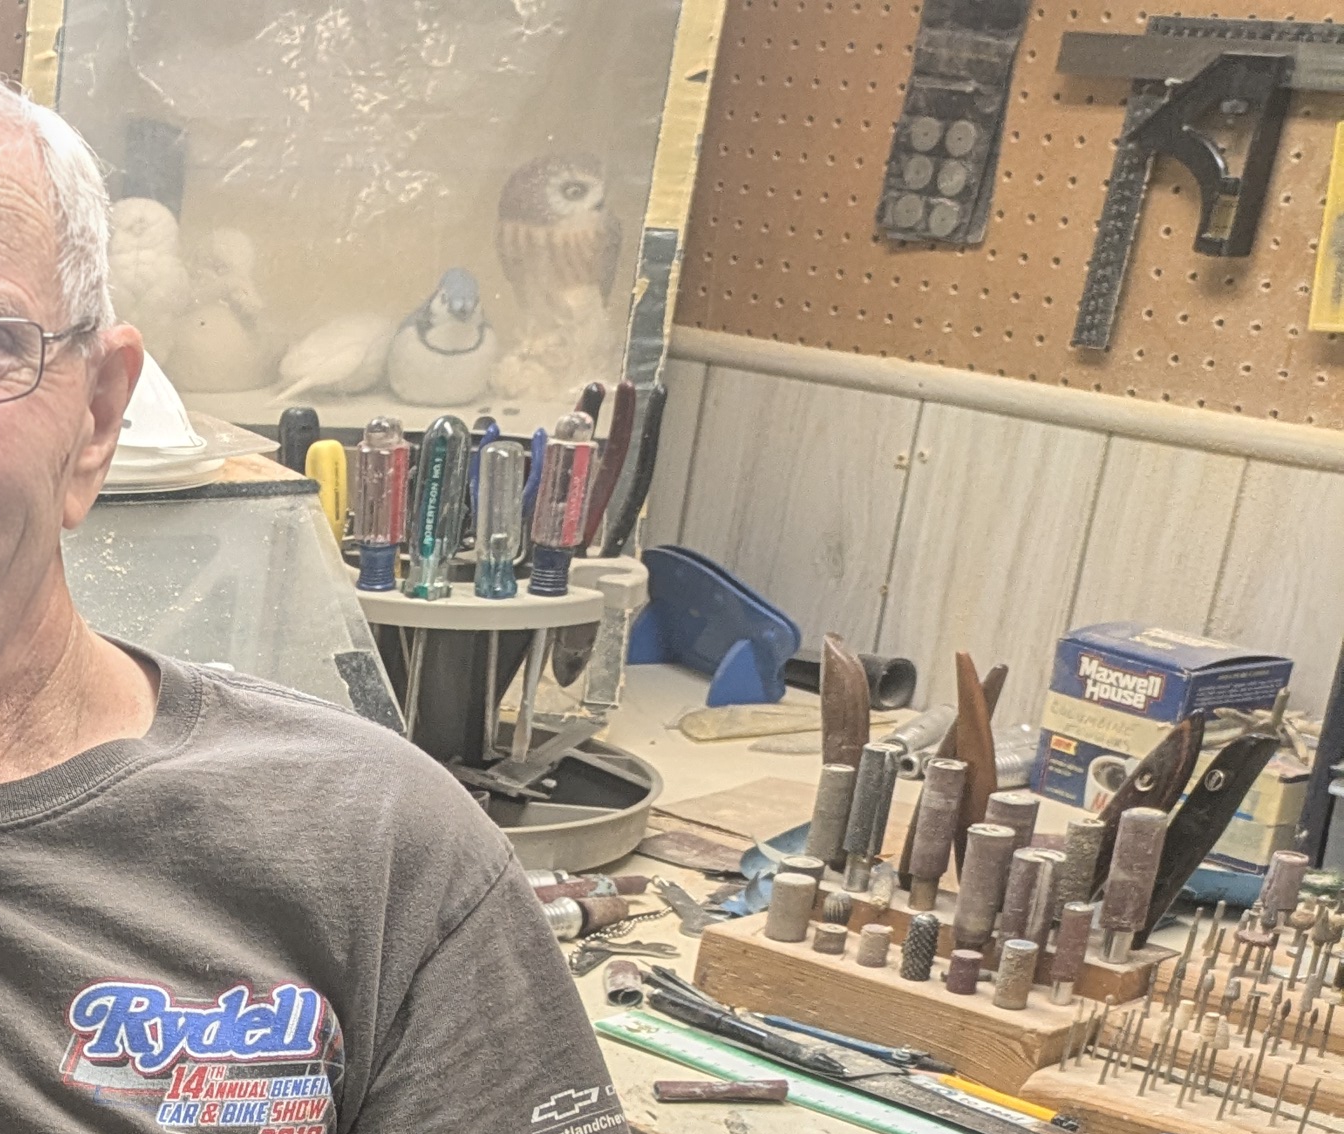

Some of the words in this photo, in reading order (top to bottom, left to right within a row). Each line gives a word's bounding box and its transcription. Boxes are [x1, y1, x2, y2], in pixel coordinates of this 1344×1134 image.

[422, 487, 439, 549] ROBERTSON
[1078, 655, 1163, 698] Maxwell
[1085, 679, 1147, 710] House
[69, 981, 322, 1074] Rydell
[203, 1080, 268, 1101] ANNUAL
[157, 1102, 199, 1125] CAR
[200, 1101, 218, 1124] &
[220, 1101, 269, 1125] BIKE
[271, 1099, 329, 1124] SHOW
